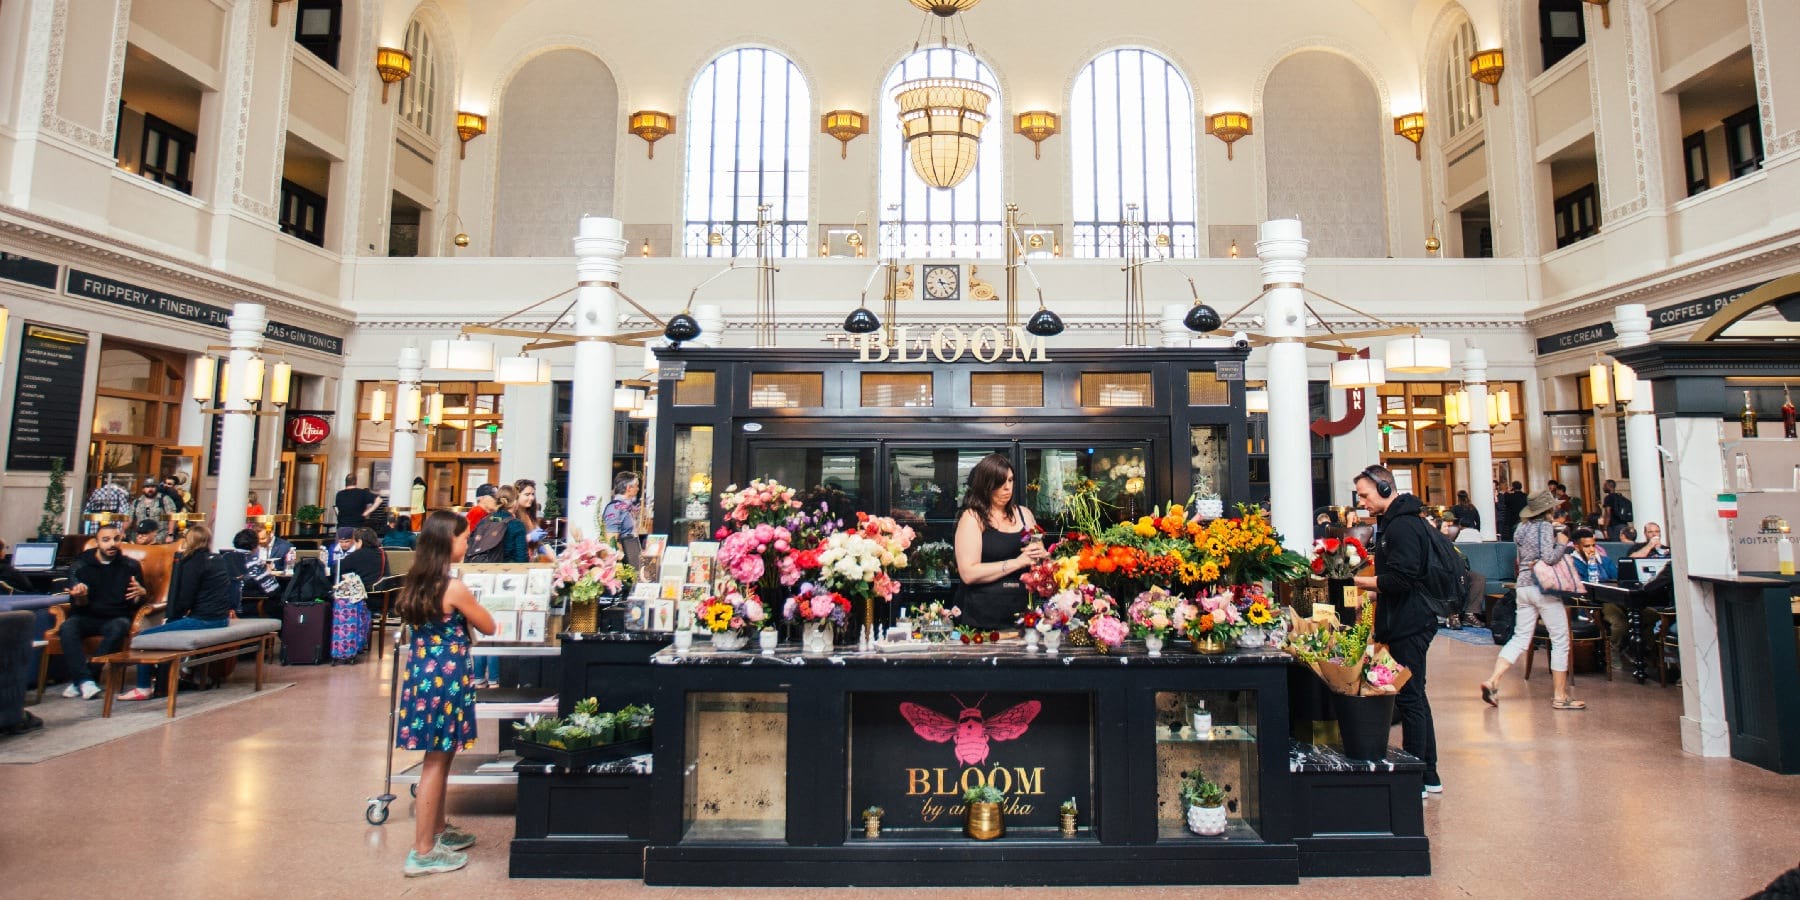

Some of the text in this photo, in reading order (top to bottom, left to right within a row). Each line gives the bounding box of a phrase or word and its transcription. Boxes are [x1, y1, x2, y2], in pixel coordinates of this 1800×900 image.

[83, 279, 149, 305] FRIPPERY
[159, 297, 201, 319] FINERY
[1659, 303, 1704, 324] COFFEE
[289, 328, 306, 344] GIN
[307, 332, 337, 350] TONICS
[852, 325, 1053, 364] BLOOM
[1559, 327, 1604, 348] ICE CREAM
[905, 766, 1046, 796] BLOOM
[920, 796, 945, 823] by
